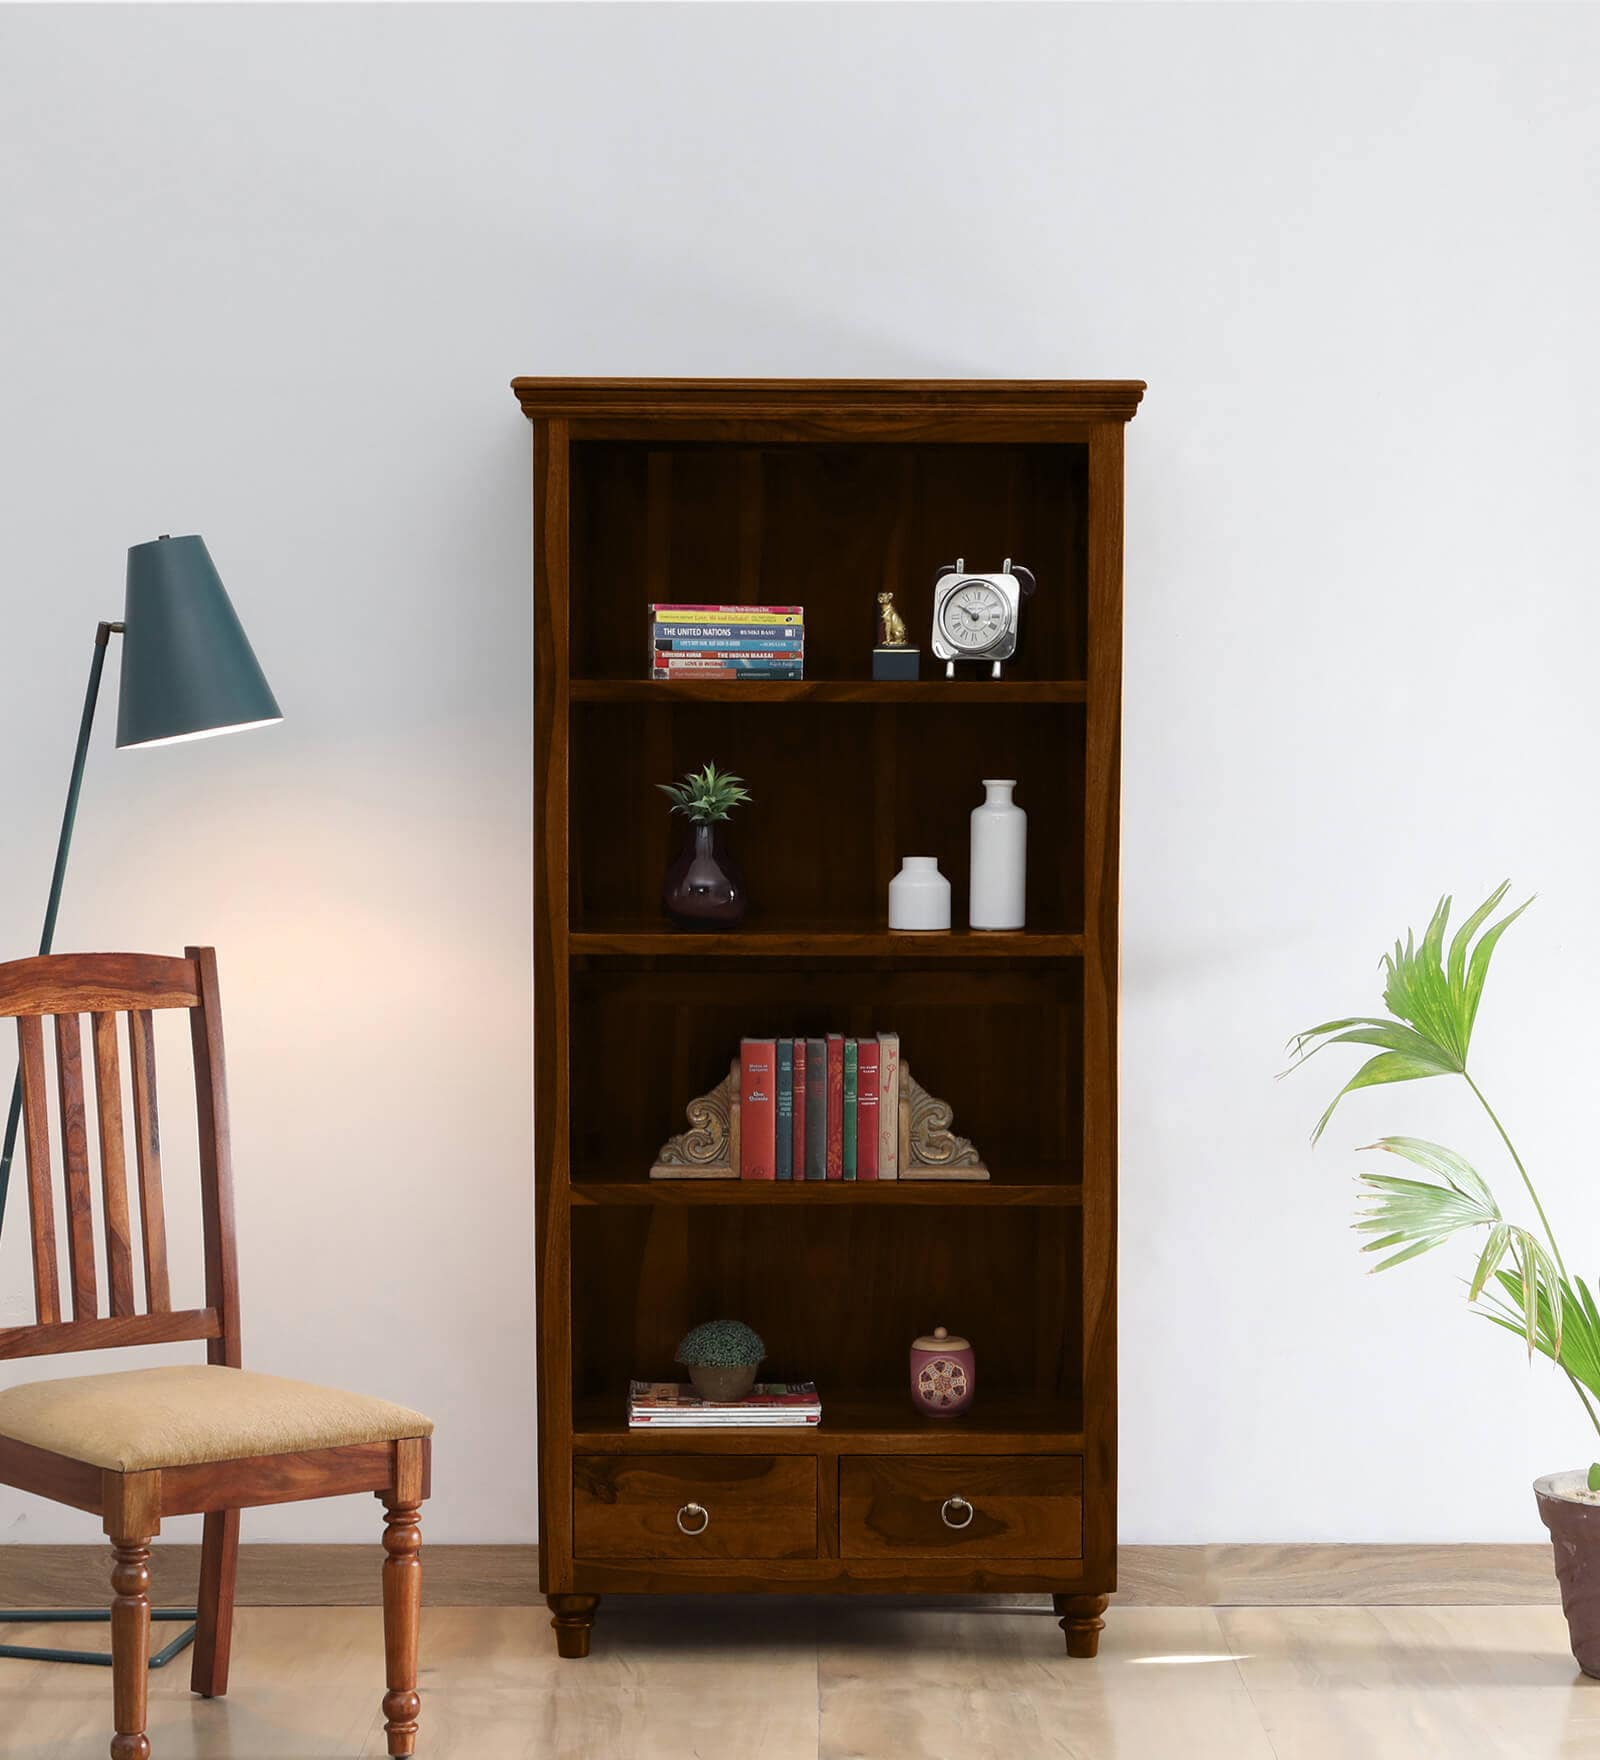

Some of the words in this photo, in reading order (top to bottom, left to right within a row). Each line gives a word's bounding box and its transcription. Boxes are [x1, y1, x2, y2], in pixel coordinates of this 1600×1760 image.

[663, 627, 676, 636] THE
[677, 627, 702, 636] UNITED
[702, 628, 732, 637] NATIONS
